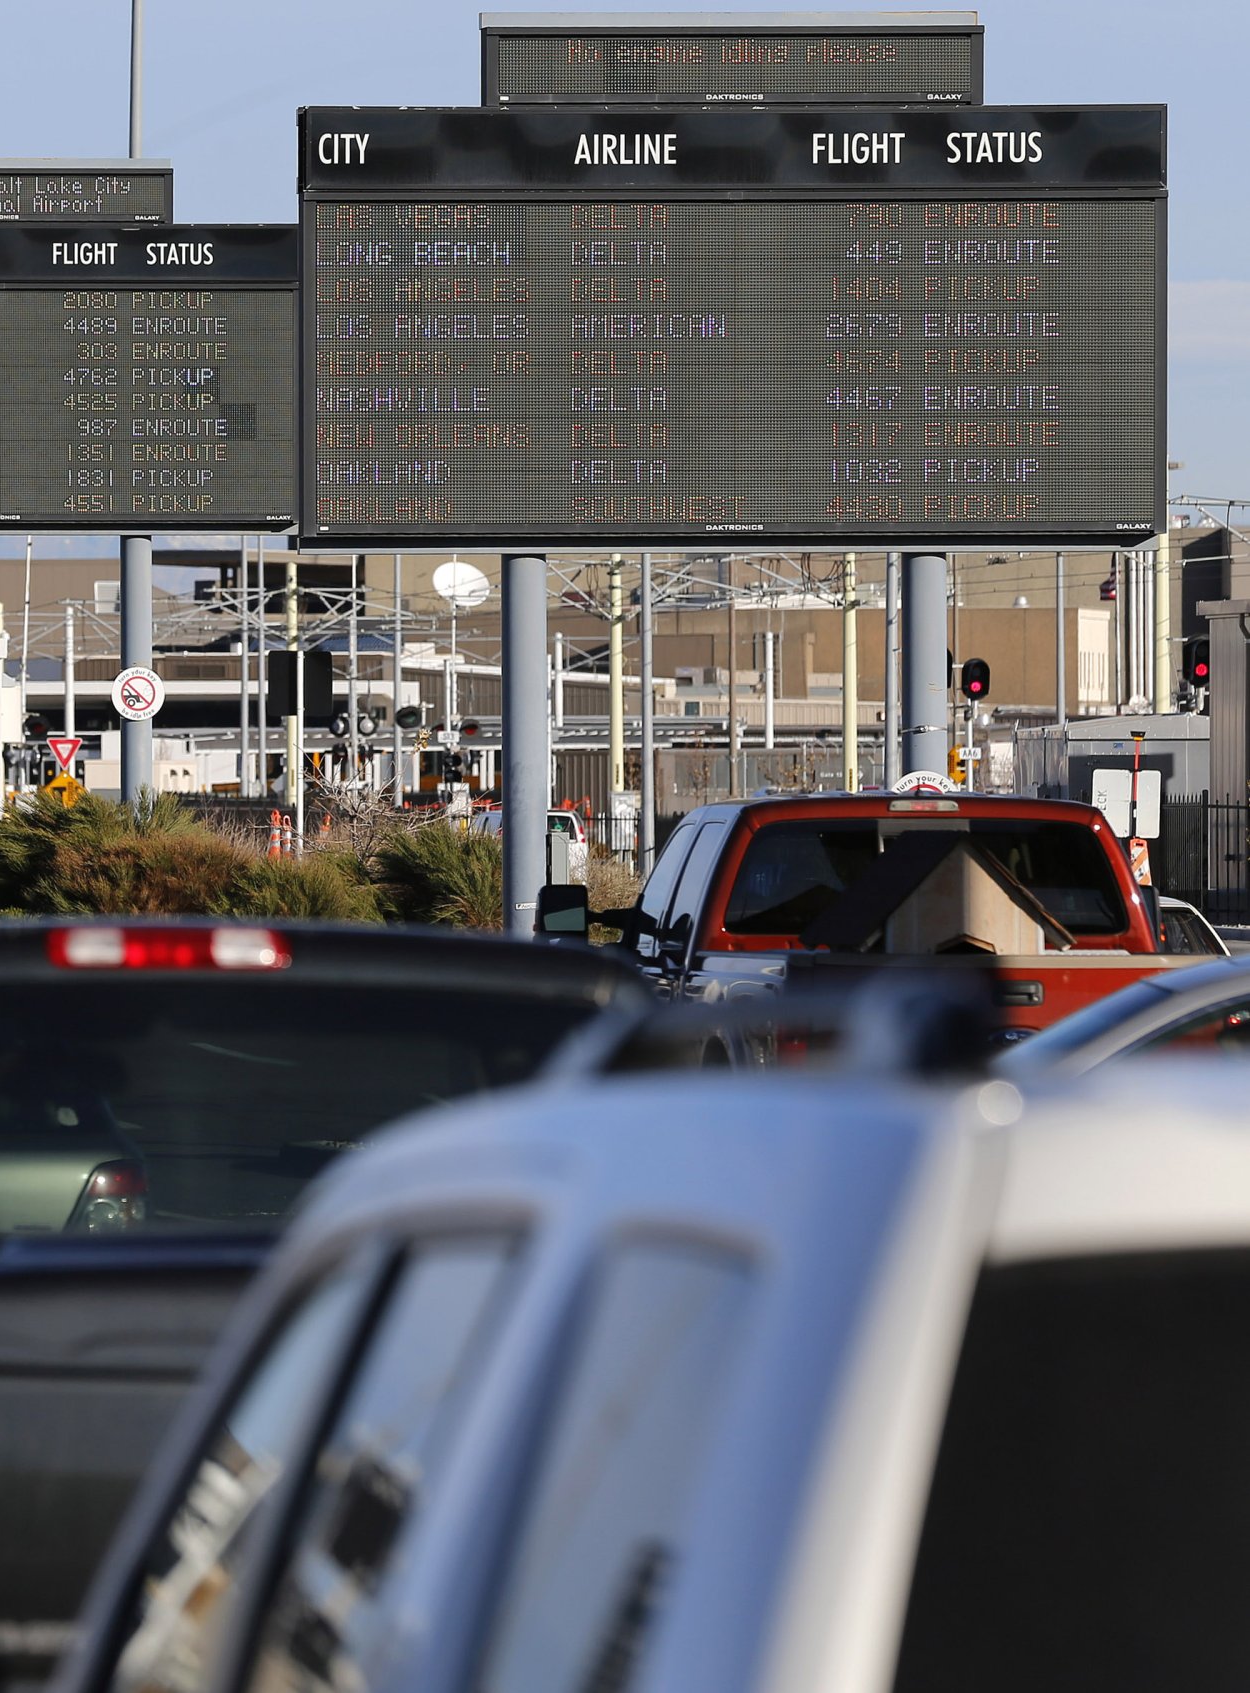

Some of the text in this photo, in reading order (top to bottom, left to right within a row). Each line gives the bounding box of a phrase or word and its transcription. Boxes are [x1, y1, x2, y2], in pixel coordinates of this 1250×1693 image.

[567, 39, 897, 63] No engine idling please
[318, 132, 1043, 164] CITY AIRLINE FLIGHT STATUS
[35, 177, 85, 195] Lake
[95, 177, 130, 195] City
[32, 196, 102, 214] Airport
[317, 204, 1060, 228] LAS VEGAS DELTA 790 ENROUTE
[52, 242, 118, 265] FLIGHT
[146, 243, 213, 265] STATUS
[317, 240, 1060, 265] LONG BEACH DELTA 449 ENROUTE
[317, 277, 1040, 302] LOS ANGELES DELTA 1404 PICKUP
[63, 292, 117, 309] 2080
[132, 292, 213, 309] PICKUP
[63, 317, 117, 334] 4489
[132, 317, 227, 334] ENROUTE
[317, 313, 1060, 338] LOS ANGELES AMERICAN 2679 ENROUTE
[77, 343, 117, 360] 303
[132, 343, 227, 360] ENROUTE
[493, 351, 529, 375] OR
[571, 351, 669, 375] DELTA
[826, 350, 901, 374] 4674
[924, 350, 1040, 374] PICKUP
[63, 368, 117, 385] 4762
[132, 368, 213, 385] PICKUP
[63, 393, 117, 411] 4525
[132, 393, 213, 411] PICKUP
[317, 386, 1060, 411] NASHVILLE DELTA 4467 ENROUTE
[78, 419, 117, 436] 987
[132, 419, 227, 436] ENROUTE
[317, 423, 1060, 448] NEW ORLEANS DELTA 1317 ENROUTE
[67, 444, 114, 461] 1351
[132, 444, 227, 461] ENROUTE
[67, 470, 114, 487] 1831
[132, 470, 213, 487] PICKUP
[317, 459, 1039, 484] OAKLAND DELTA 1032 PICKUP
[63, 495, 114, 512] 4551
[132, 495, 213, 512] PICKUP
[317, 495, 1040, 521] OAKLAND SOUTHWEST 4430 PICKUP
[896, 778, 914, 792] turn
[915, 776, 936, 785] your
